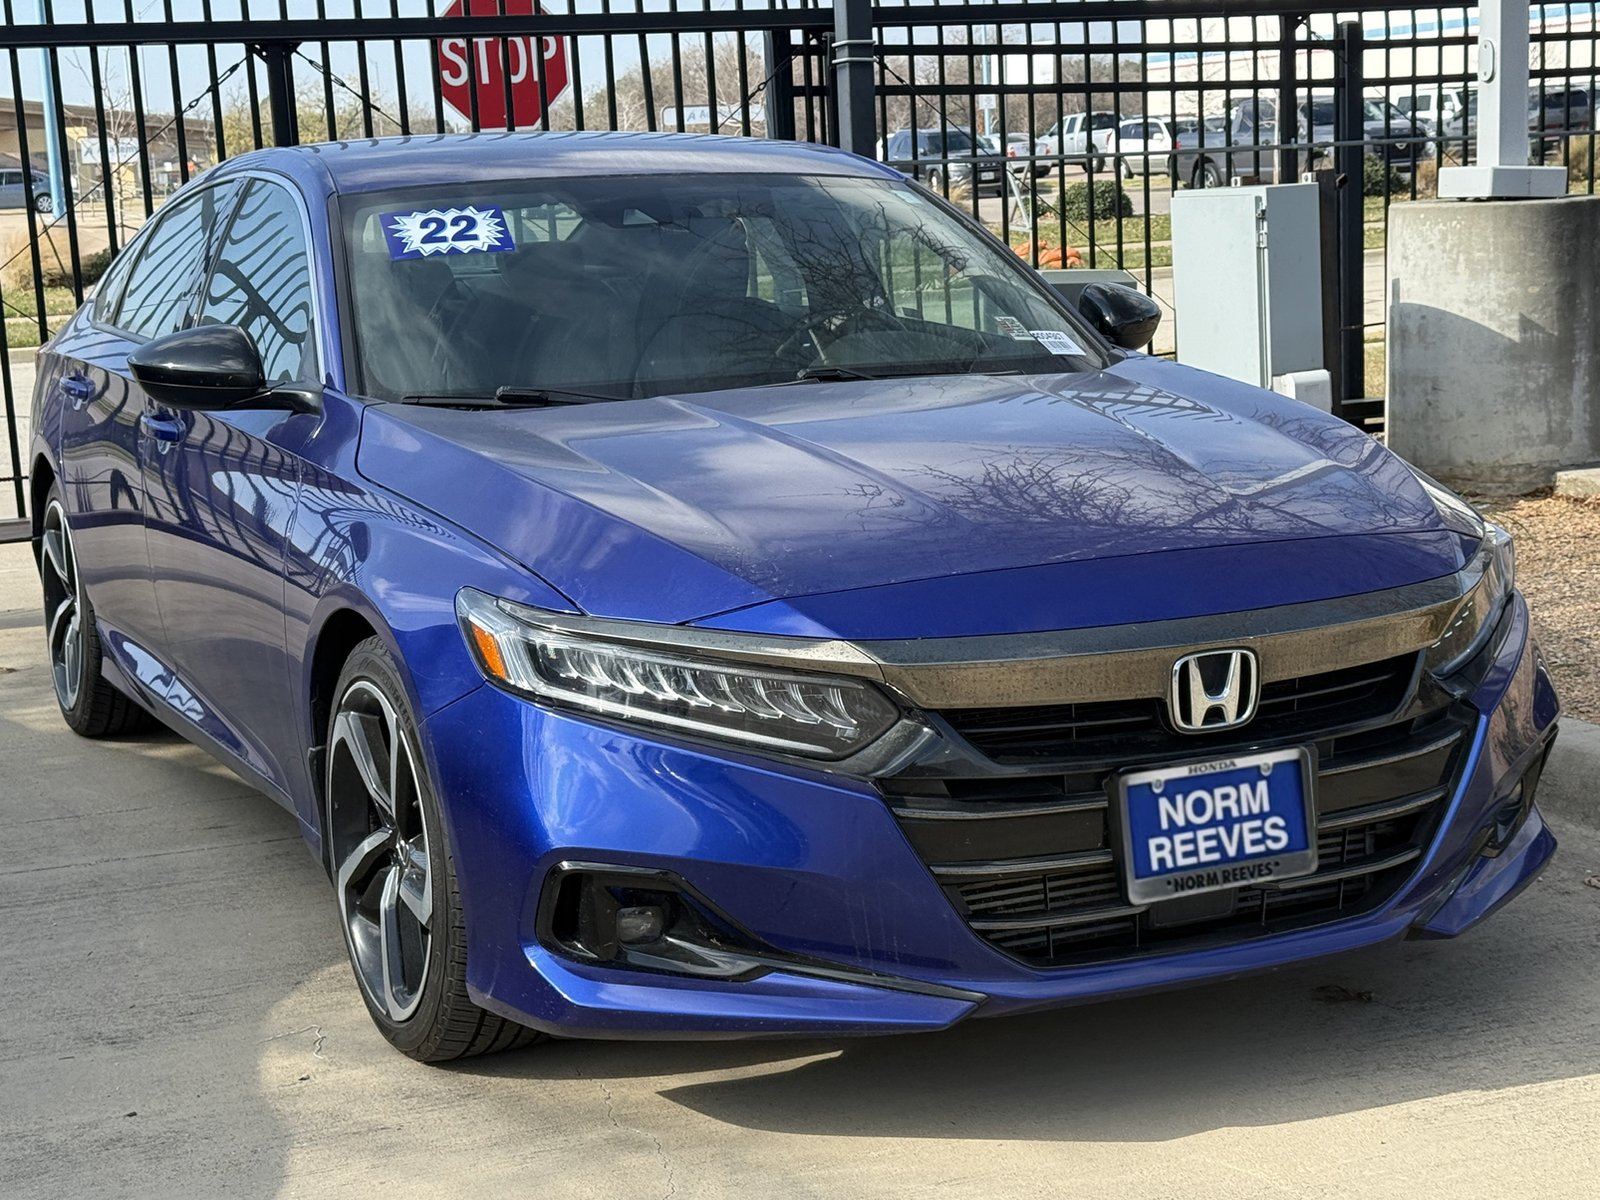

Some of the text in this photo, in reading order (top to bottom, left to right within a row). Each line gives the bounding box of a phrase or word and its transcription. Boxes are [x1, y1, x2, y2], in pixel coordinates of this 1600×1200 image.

[441, 36, 557, 87] STOP
[419, 215, 480, 245] 22
[1188, 760, 1238, 776] HONDA
[1157, 779, 1271, 831] NORM
[1147, 815, 1290, 872] REEVES
[1173, 862, 1274, 893] NORM REEVES
